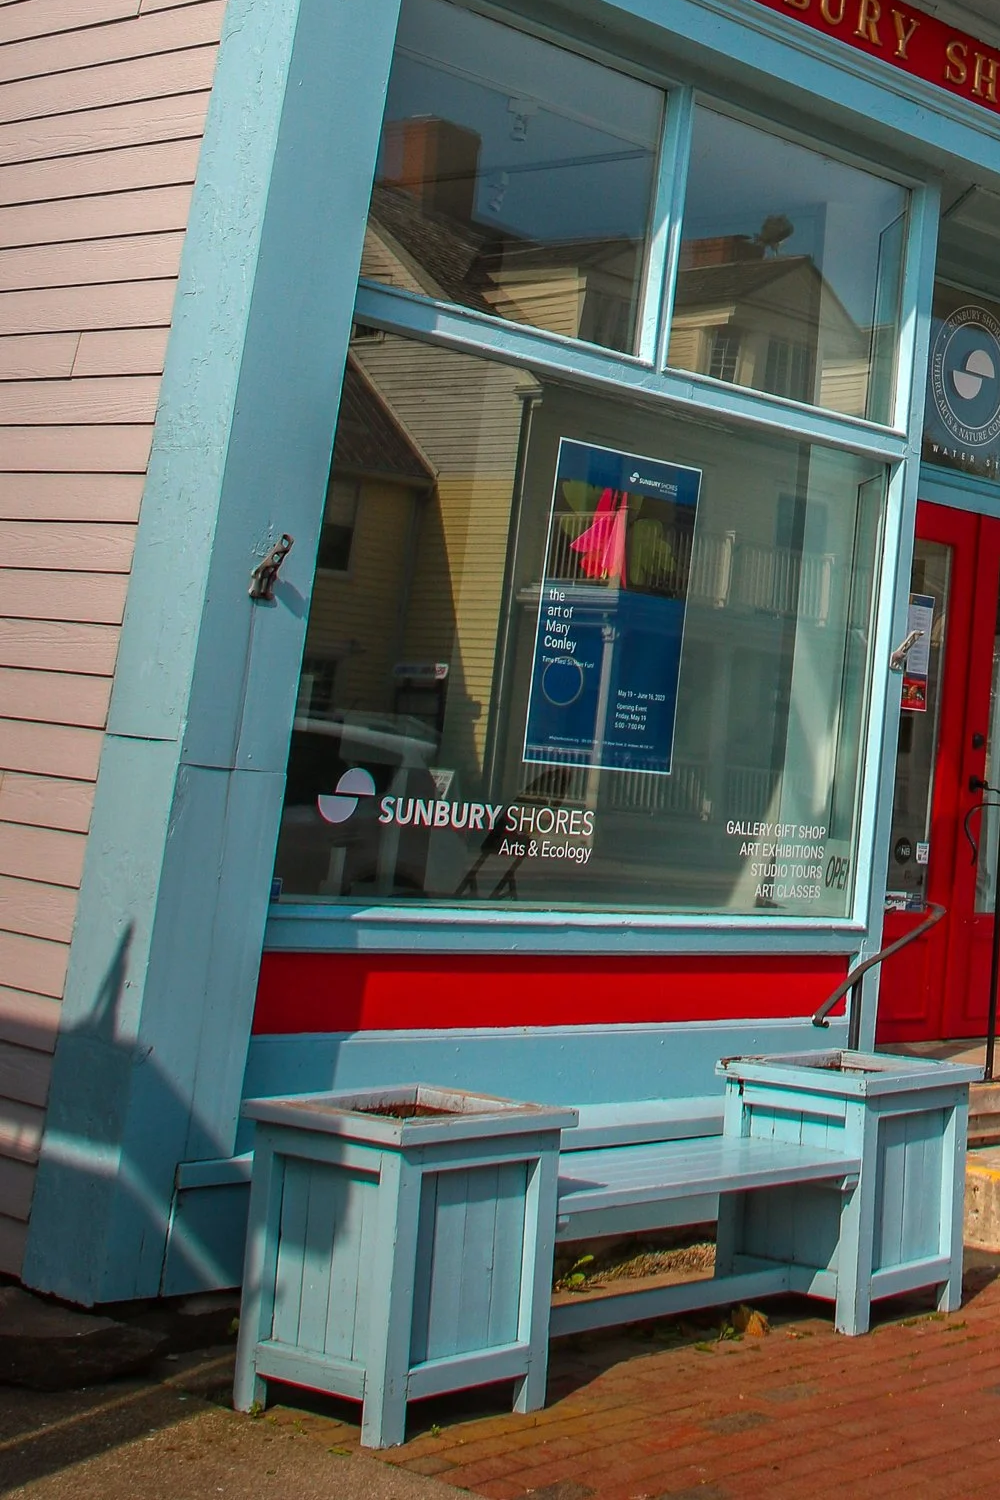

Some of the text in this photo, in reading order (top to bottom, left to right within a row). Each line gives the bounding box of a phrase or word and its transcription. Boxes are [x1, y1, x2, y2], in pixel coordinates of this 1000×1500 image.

[948, 309, 981, 331] SUNBURY
[934, 353, 943, 397] WHERE
[938, 399, 954, 425] ARTS
[958, 427, 988, 442] NATURE
[932, 444, 975, 463] WATER
[549, 587, 566, 602] the
[547, 605, 574, 619] art of
[545, 618, 571, 637] Mary
[544, 634, 577, 654] Conley
[378, 796, 595, 837] SUNBURY SHORES
[726, 820, 827, 841] GALLERY GIFT SHOP
[498, 838, 593, 865] Arts & Ecology
[739, 841, 825, 860] ART EXHIBITIONS
[750, 862, 823, 880] STUDIO TOURS
[754, 883, 821, 900] ART CLASSES
